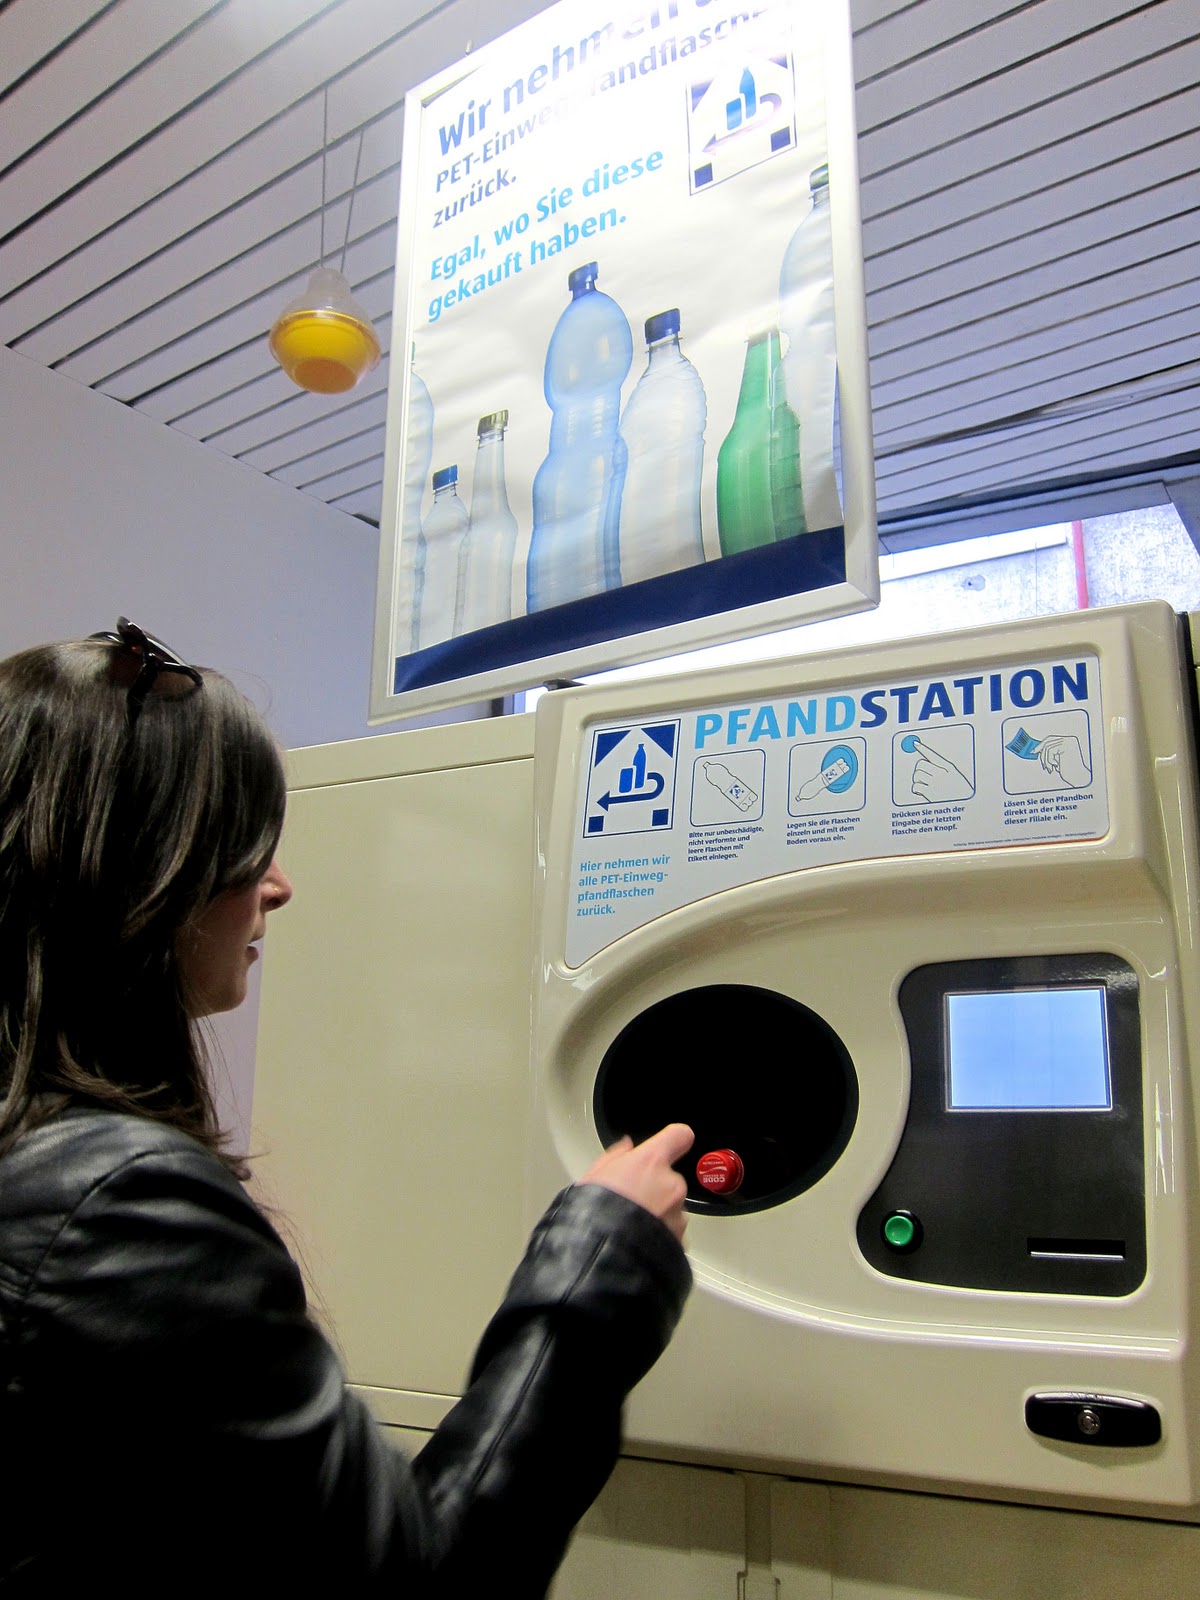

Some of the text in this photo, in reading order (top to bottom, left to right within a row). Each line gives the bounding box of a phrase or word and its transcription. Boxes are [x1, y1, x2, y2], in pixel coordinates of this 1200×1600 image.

[438, 98, 492, 156] Wir
[432, 167, 517, 229] zurück.
[430, 150, 664, 281] Egal, wo Sie diese
[427, 207, 627, 323] gekauft haben.
[1003, 792, 1094, 808] Lösen Sie den Pfandbon
[891, 805, 965, 819] Drücken Sie nach der
[1003, 808, 1027, 817] direkt
[1040, 804, 1054, 813] der
[1054, 803, 1078, 811] Kasse
[787, 815, 860, 830] Legen Sie die Flaschen
[891, 814, 961, 828] Eingabe der letzten
[1004, 812, 1068, 826] dieser Filiale ein.
[688, 831, 703, 839] Bitte
[786, 825, 855, 837] einzeln und mit dem
[891, 822, 958, 836] Flasche den Knopf.
[688, 834, 750, 847] nicht verformte und
[786, 834, 846, 846] Boden voraus ein.
[687, 847, 704, 855] leere
[705, 844, 732, 853] Flaschen
[580, 853, 671, 872] Hier nehmen wir
[687, 853, 739, 863] Etikett einlegen.
[578, 870, 669, 887] alle PET-Einweg-
[577, 886, 655, 904] pfandflaschen
[576, 903, 616, 917] zurück.
